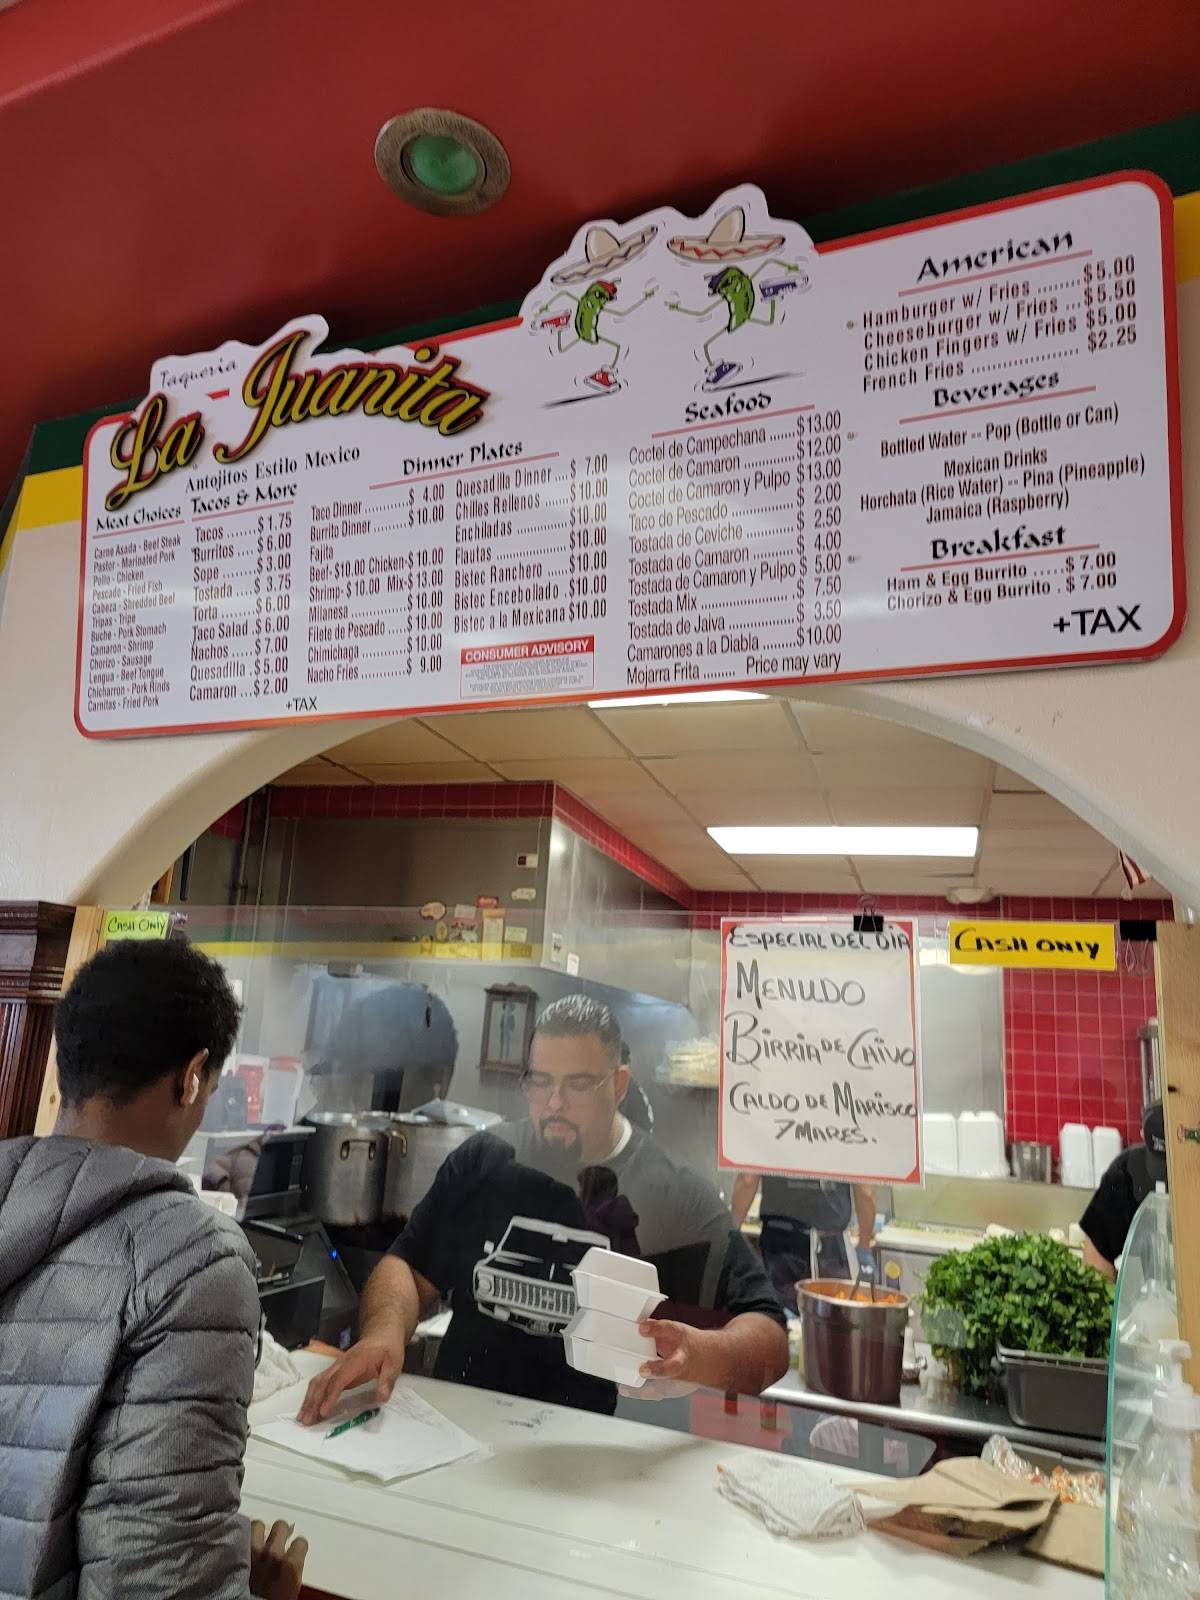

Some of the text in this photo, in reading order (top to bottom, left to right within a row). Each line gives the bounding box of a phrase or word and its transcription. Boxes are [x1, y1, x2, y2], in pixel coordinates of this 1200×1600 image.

[916, 231, 1074, 283] American
[863, 298, 956, 329] Hamburger
[990, 280, 1030, 299] Fries
[864, 315, 982, 349] Cheeseburger
[1017, 297, 1058, 317] Fries
[864, 348, 929, 372] Chicken
[936, 333, 999, 358] Fingers
[1035, 316, 1077, 337] Fries
[161, 357, 237, 388] Taqueria
[863, 326, 1136, 393] French Fries $2.25
[934, 372, 1059, 408] Beverages
[105, 330, 490, 511] La Juanita
[686, 394, 771, 423] Seafood
[881, 433, 925, 458] Bottled
[929, 429, 967, 451] Water
[986, 421, 1011, 442] Pop
[1016, 415, 1061, 440] (Bottle
[1067, 414, 1081, 428] or
[1085, 402, 1118, 426] Can)
[403, 441, 523, 476] Dinner Plates
[630, 446, 664, 465] Coctel
[669, 441, 682, 458] de
[687, 428, 766, 453] Campechana
[185, 447, 360, 493] Antojitos Estilo Mexico
[629, 468, 664, 488] Coctel
[668, 464, 682, 480] de
[687, 456, 740, 478] Camaron
[944, 447, 1047, 477] Mexican Drinks
[629, 490, 664, 510] Coctel
[668, 487, 682, 502] de
[687, 478, 740, 500] Camaron
[744, 479, 749, 495] y
[755, 470, 790, 492] Pulpo
[861, 488, 916, 513] Horchata
[921, 481, 954, 506] (Rice
[959, 473, 1003, 499] Water)
[1059, 453, 1145, 487] (Pineapple)
[190, 483, 298, 515] Tacos & More
[311, 501, 362, 521] Taco Dinner
[926, 489, 1069, 524] Jamaica (Raspberry)
[96, 506, 181, 531] Meat Choices
[659, 511, 672, 527] de
[677, 502, 728, 523] Pescado
[196, 525, 223, 541] Tacos
[455, 520, 512, 543] Enchiladas
[629, 521, 742, 554] Tostada de Ceviche
[931, 525, 1065, 561] Breakfast
[194, 544, 233, 562] Burritos
[455, 547, 492, 565] Flautas
[629, 546, 749, 576] Tostada de Camaron
[194, 567, 218, 583] Sope
[455, 568, 485, 588] Bistec
[491, 562, 542, 583] Ranchero
[629, 561, 796, 597] Tostada de Camaron y Pulpo
[887, 574, 920, 592] Ham
[926, 572, 936, 586] &
[942, 569, 969, 588] Egg
[975, 563, 1027, 583] Burrito
[194, 583, 232, 602] Tostada
[629, 596, 697, 618] Tostada Mix
[887, 591, 942, 611] Chorizo
[948, 588, 958, 604] &
[964, 584, 992, 605] Egg
[997, 581, 1050, 601] Burrito
[193, 605, 217, 621] Torta
[629, 614, 725, 639] Tostada de Jaiva
[1053, 605, 1143, 638] +TAX
[192, 622, 248, 640] Taco Salad
[191, 644, 229, 661] Nachos
[466, 639, 589, 662] CONSUMER ADVISORY
[628, 641, 692, 662] Camarones
[696, 642, 702, 654] a
[707, 637, 716, 653] la
[721, 631, 759, 652] Diabla
[191, 661, 245, 681] Quesadilla
[628, 652, 840, 688] Mojarra Frita Price may vary
[190, 683, 236, 701] Camaron
[830, 931, 870, 950] DEL
[737, 960, 865, 1009] MENUDO
